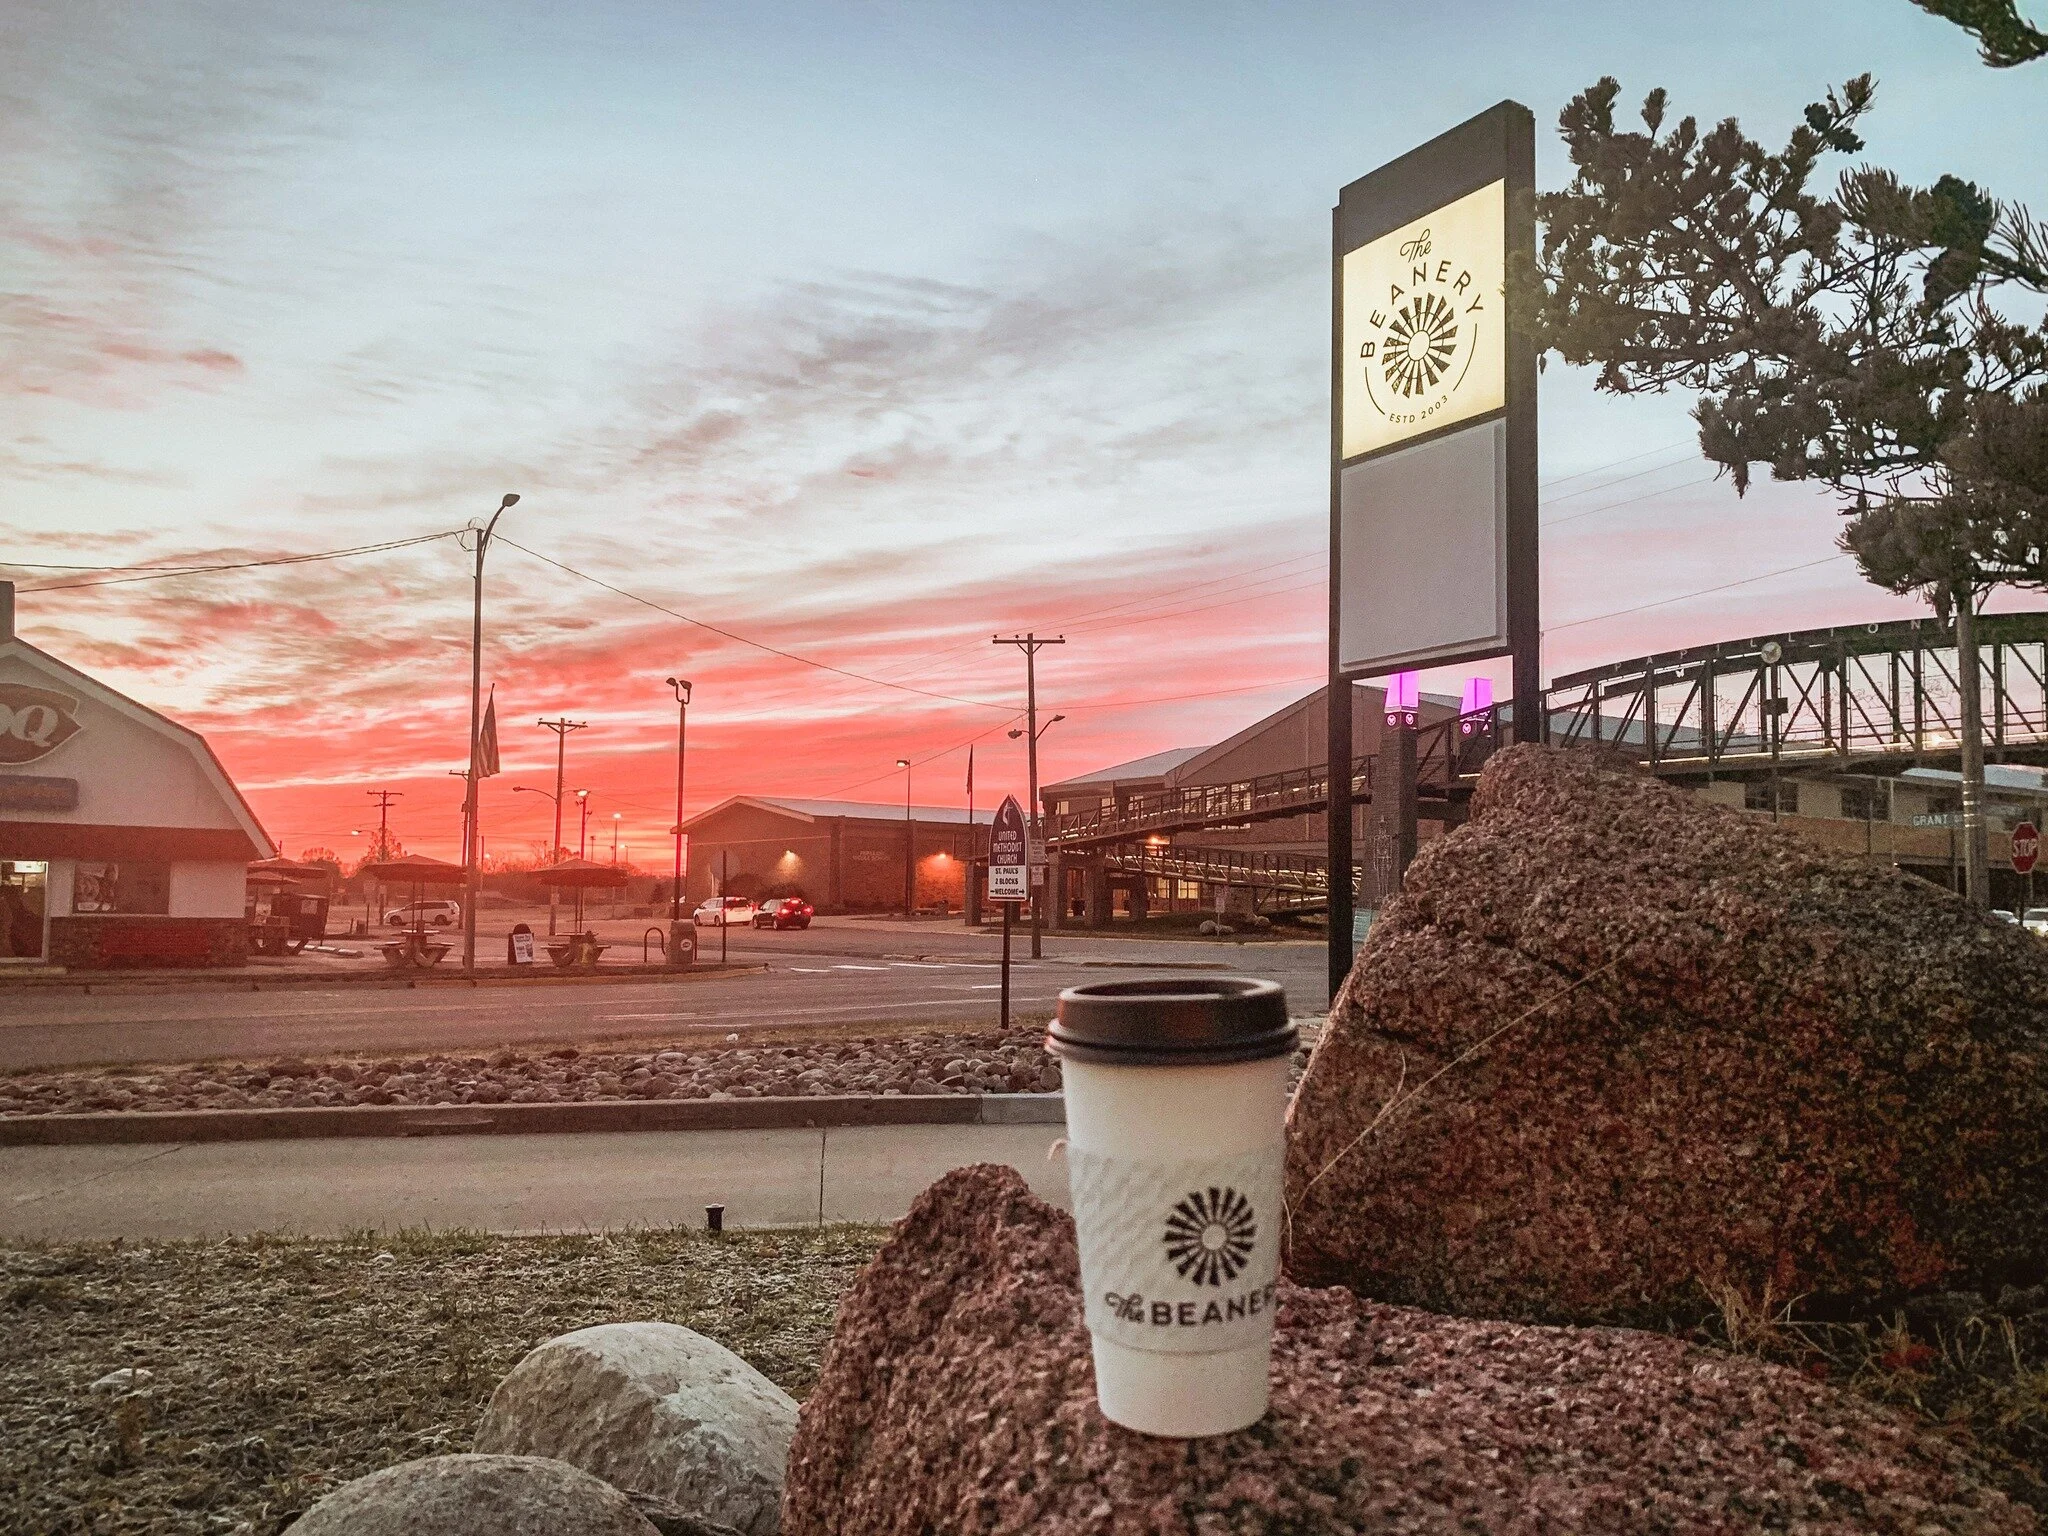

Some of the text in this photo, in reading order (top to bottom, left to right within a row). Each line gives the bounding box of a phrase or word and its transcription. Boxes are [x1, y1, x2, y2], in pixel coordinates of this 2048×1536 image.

[1400, 228, 1431, 263] The
[1360, 260, 1484, 359] BEANERY
[1389, 395, 1448, 423] ESTD 2003
[1912, 813, 1948, 826] GRANT
[999, 831, 1016, 841] UNITED
[993, 842, 1022, 853] METHODIST
[2012, 839, 2037, 857] STOP
[997, 854, 1017, 864] CHURCH
